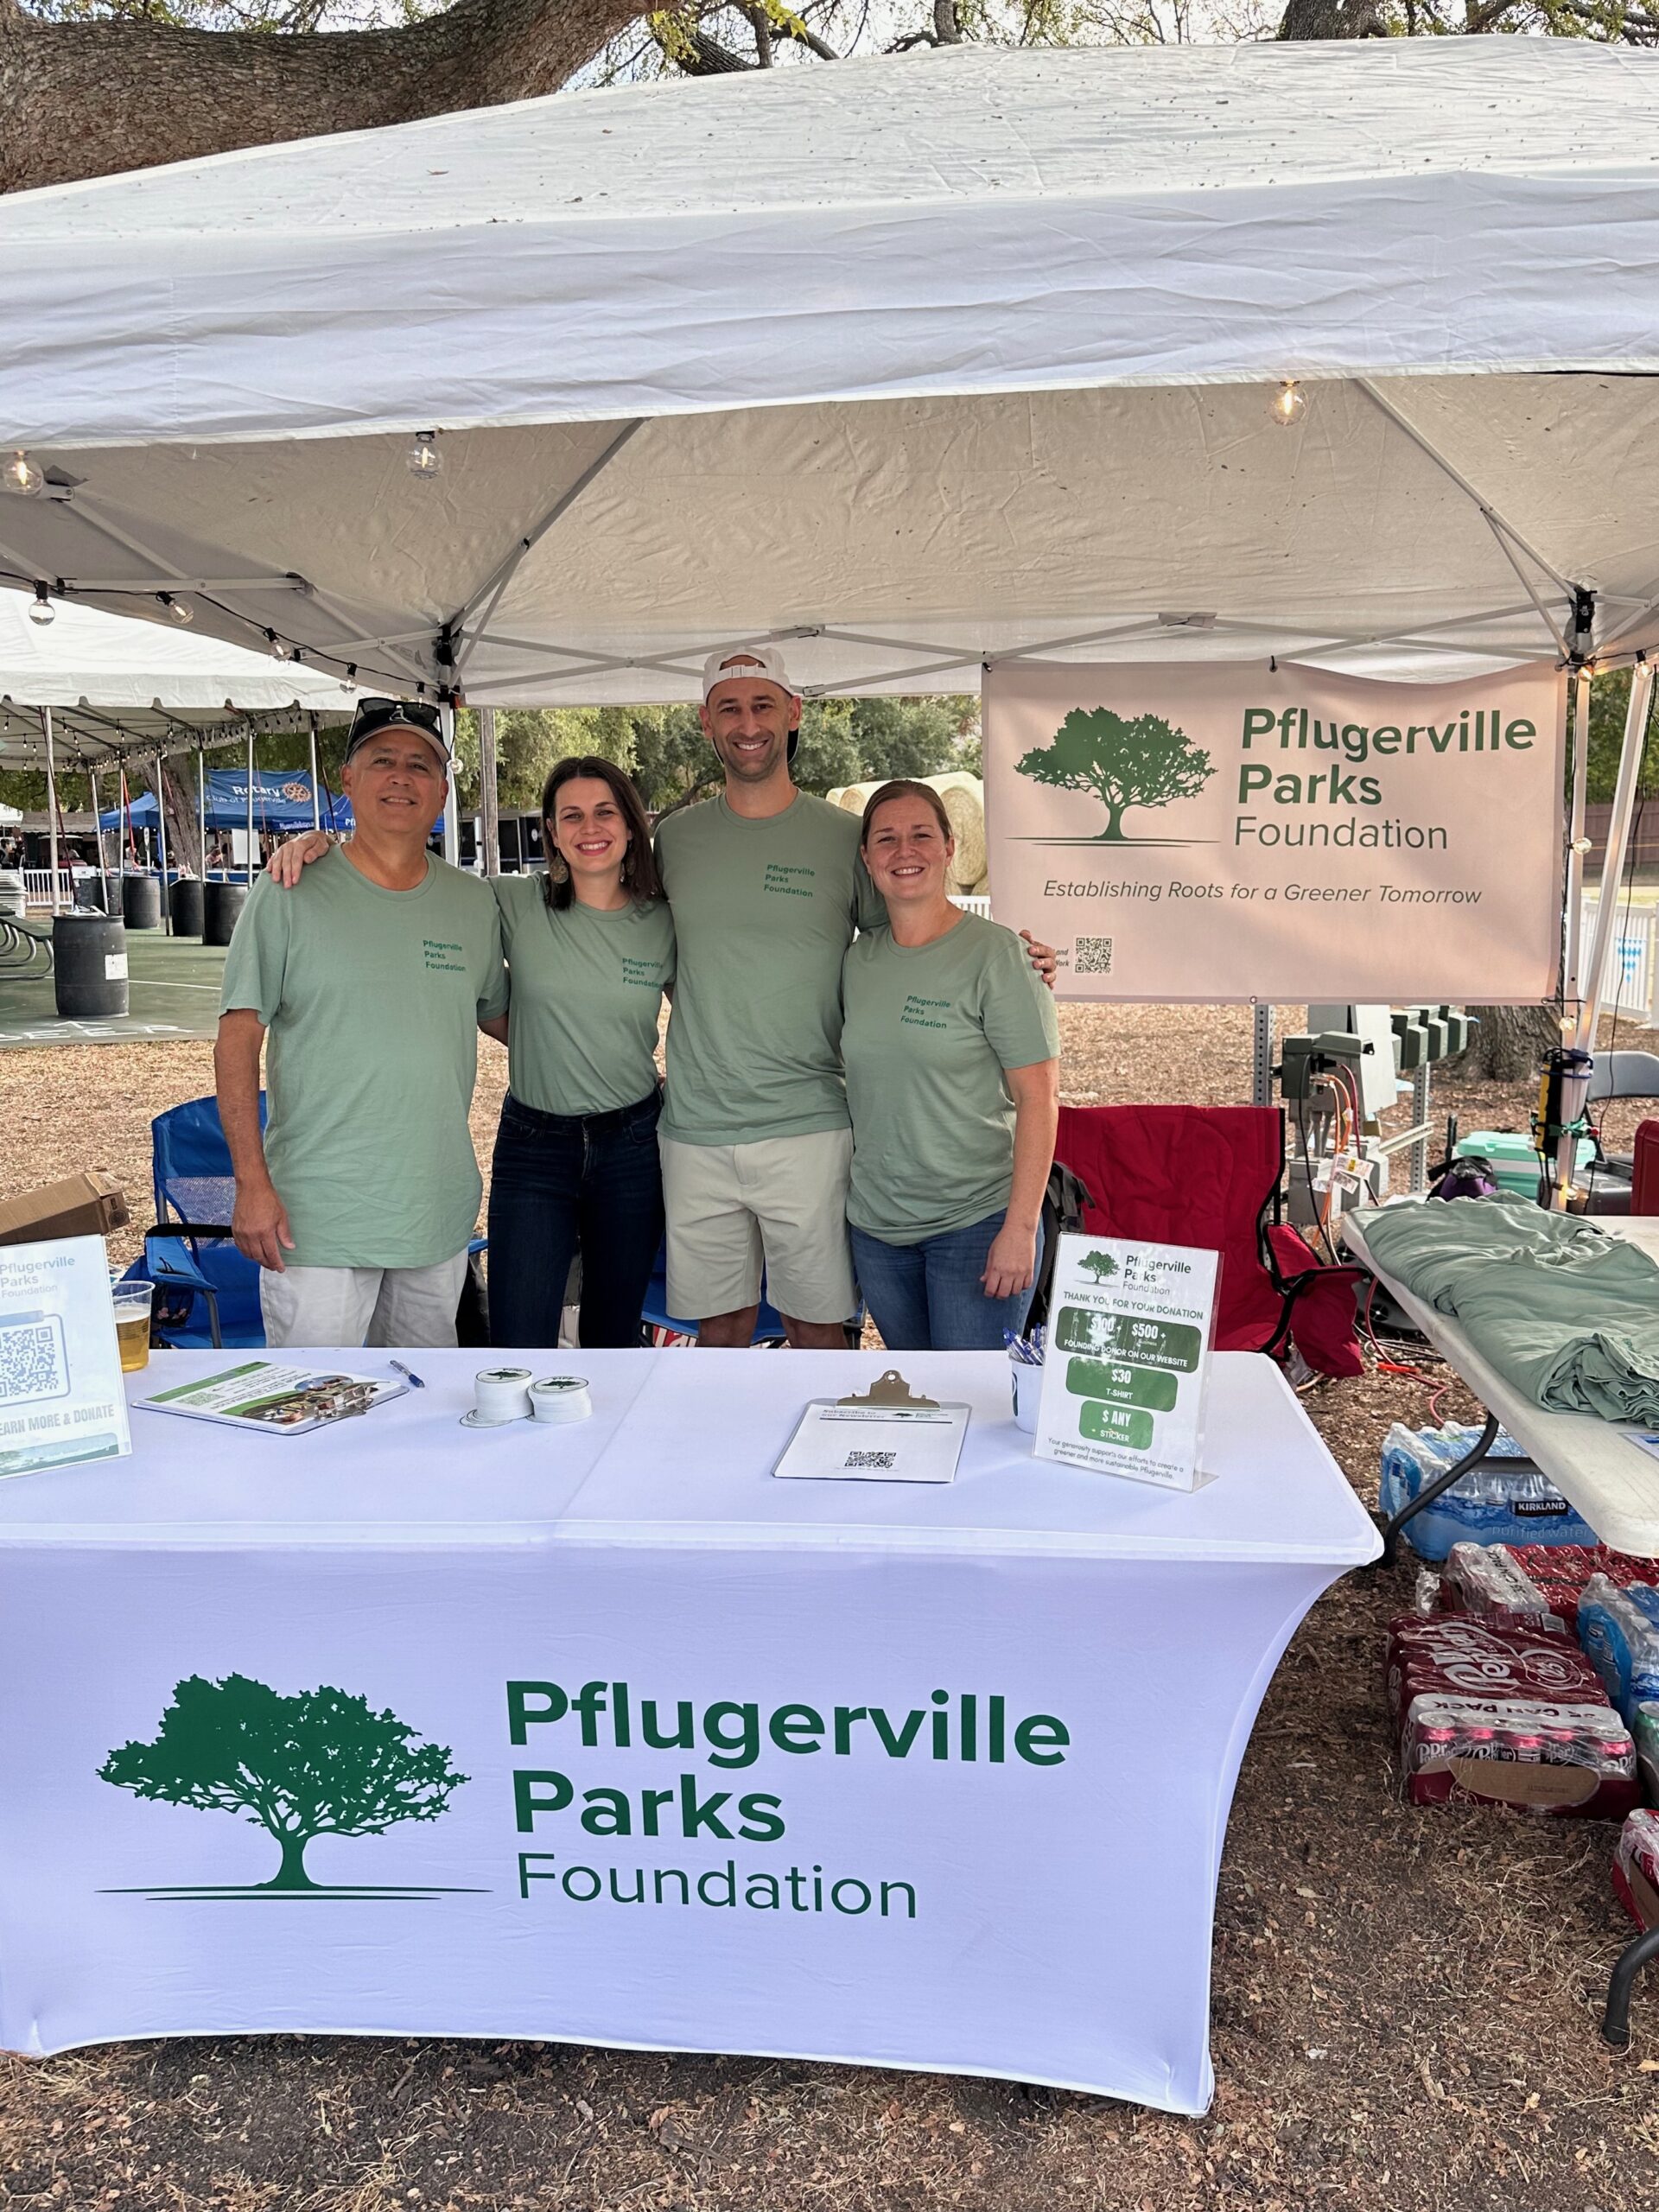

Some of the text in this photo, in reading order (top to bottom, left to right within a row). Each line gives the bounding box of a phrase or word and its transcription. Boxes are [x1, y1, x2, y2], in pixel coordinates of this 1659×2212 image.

[1242, 708, 1536, 762] Pflugerville
[232, 785, 280, 798] Rotary
[1238, 764, 1382, 805] Parks
[1236, 817, 1446, 849] Foundation
[767, 864, 815, 877] Pflugerville
[765, 874, 789, 883] Parks
[764, 884, 813, 898] Foundation
[1044, 880, 1482, 904] Establishing Roots for a Greener Tomorrow
[423, 940, 463, 951] Pflugerville
[424, 950, 446, 959] Parks
[425, 961, 467, 972] Foundation
[623, 967, 645, 976] Parks
[907, 995, 950, 1008] Pflugerville
[904, 1005, 925, 1015] Parks
[900, 1015, 947, 1029] Foundation
[0, 1256, 75, 1274] Pflugerville
[1, 1274, 39, 1288] Parks
[1124, 1268, 1156, 1282] Paks
[1, 1285, 58, 1299] Foundation
[1123, 1281, 1170, 1295] Foundation
[1064, 1291, 1090, 1303] THANK
[1112, 1299, 1129, 1309] FOR
[1131, 1300, 1155, 1313] YOUR
[1156, 1304, 1204, 1320] DONATION
[1131, 1323, 1159, 1339] $500
[1064, 1339, 1100, 1352] FOUNDING
[1128, 1350, 1140, 1359] ON
[1140, 1351, 1156, 1362] OUR
[1156, 1355, 1189, 1368] WEBSITE
[1111, 1369, 1132, 1384] $30
[1106, 1388, 1134, 1400] T-SHIRT
[28, 1413, 61, 1431] MORE
[63, 1413, 71, 1426] &
[73, 1404, 115, 1423] DONATE
[1102, 1409, 1132, 1427] $ ANY
[1100, 1430, 1130, 1443] STICKER
[1048, 1437, 1061, 1446] Your
[1061, 1440, 1091, 1454] generosity
[1053, 1447, 1076, 1459] greener
[1076, 1451, 1089, 1460] and
[1089, 1455, 1104, 1465] more
[1518, 1502, 1567, 1511] KIRKLAND
[1491, 1526, 1587, 1539] purified water
[1433, 1700, 1497, 1713] PACK
[505, 1680, 1071, 1769] Pflugerville
[513, 1770, 785, 1842] Parks
[518, 1852, 917, 1918] Foundation
